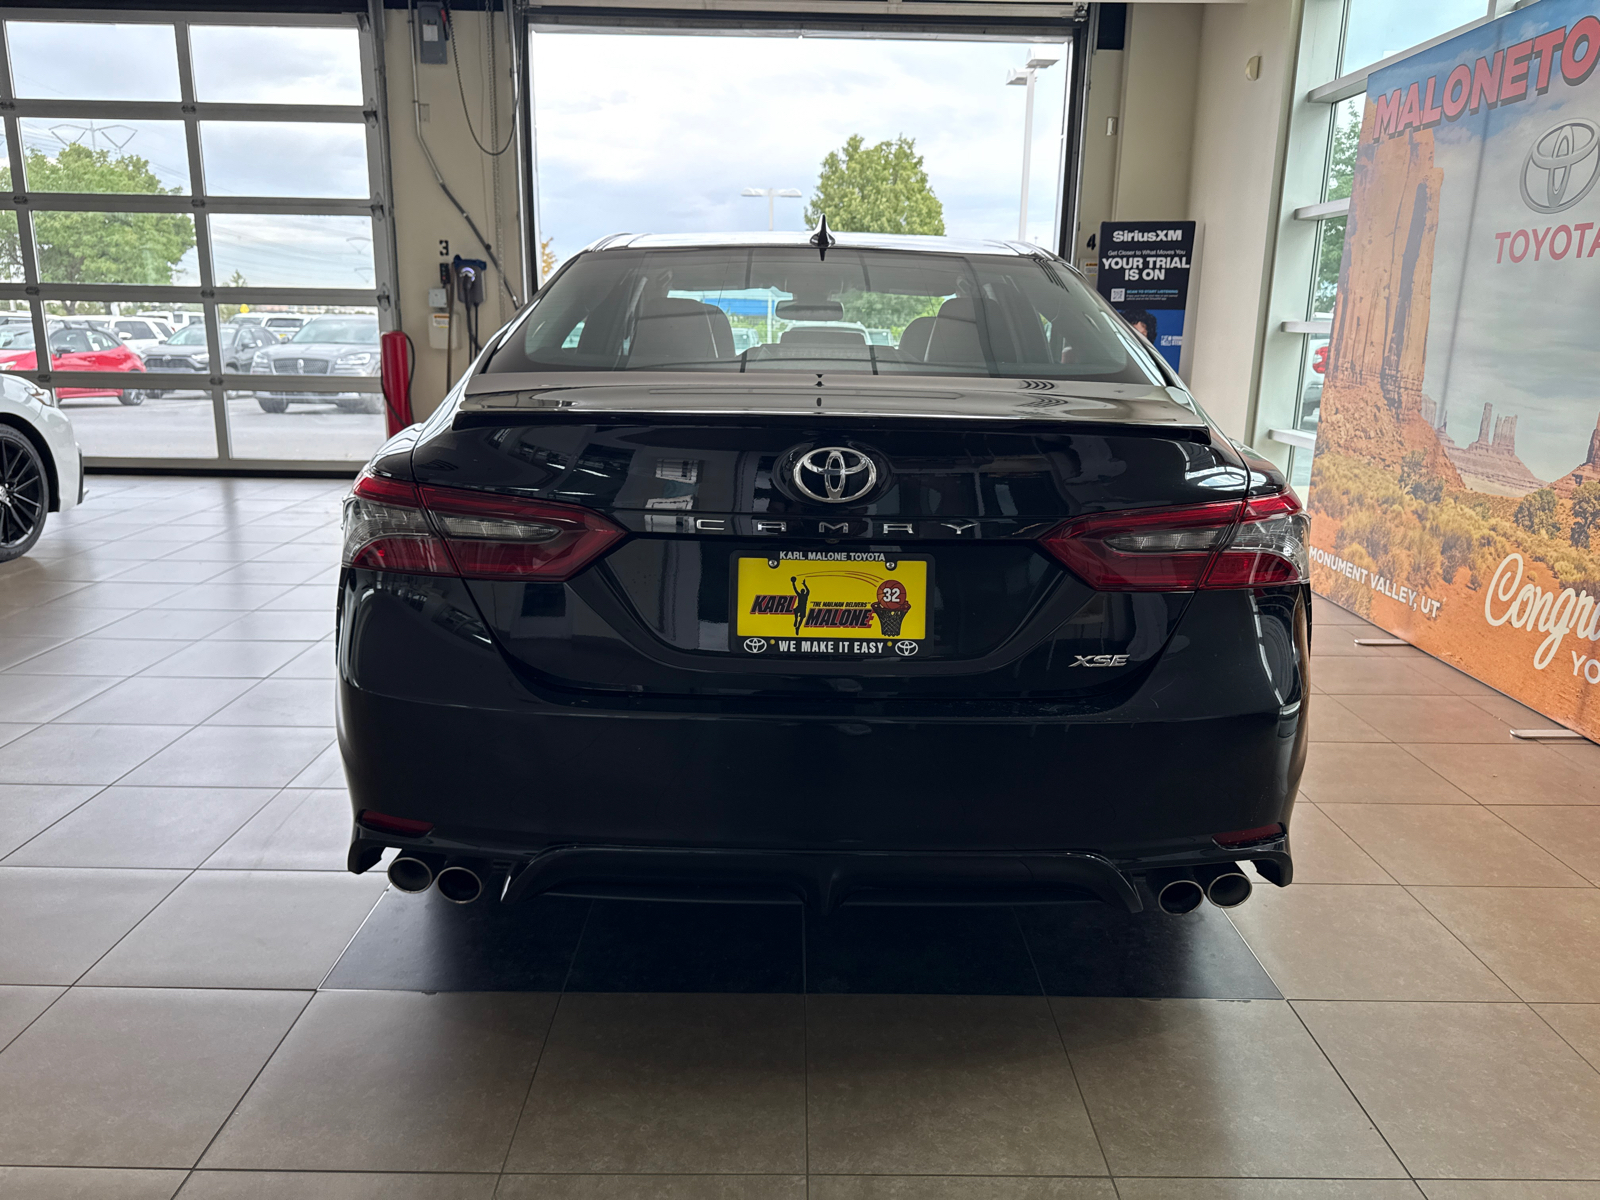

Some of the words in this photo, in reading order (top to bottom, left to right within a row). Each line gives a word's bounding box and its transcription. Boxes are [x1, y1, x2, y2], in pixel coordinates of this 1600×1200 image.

[1373, 15, 1600, 144] MALONETO
[1086, 233, 1096, 251] 4
[1113, 229, 1182, 242] SiriusXM
[439, 240, 449, 256] 3
[1102, 257, 1143, 269] YOUR
[1146, 257, 1190, 268] TRIAL
[1125, 269, 1139, 280] IS
[1142, 269, 1165, 280] ON
[696, 519, 978, 534] CAMRY
[779, 551, 805, 560] KARL
[807, 551, 848, 561] MALONE
[849, 552, 885, 561] TOYOTA
[1309, 545, 1368, 584] MONUMENT
[1370, 572, 1417, 612] VALLEY,
[1420, 595, 1441, 618] UT
[883, 587, 900, 602] 32
[750, 595, 798, 615] KARL
[804, 608, 875, 628] MALONE
[779, 640, 796, 652] WE
[801, 641, 834, 652] MAKE
[839, 641, 848, 653] IT
[854, 642, 884, 654] EASY
[1068, 654, 1130, 667] XSE
[1571, 650, 1600, 684] YO
